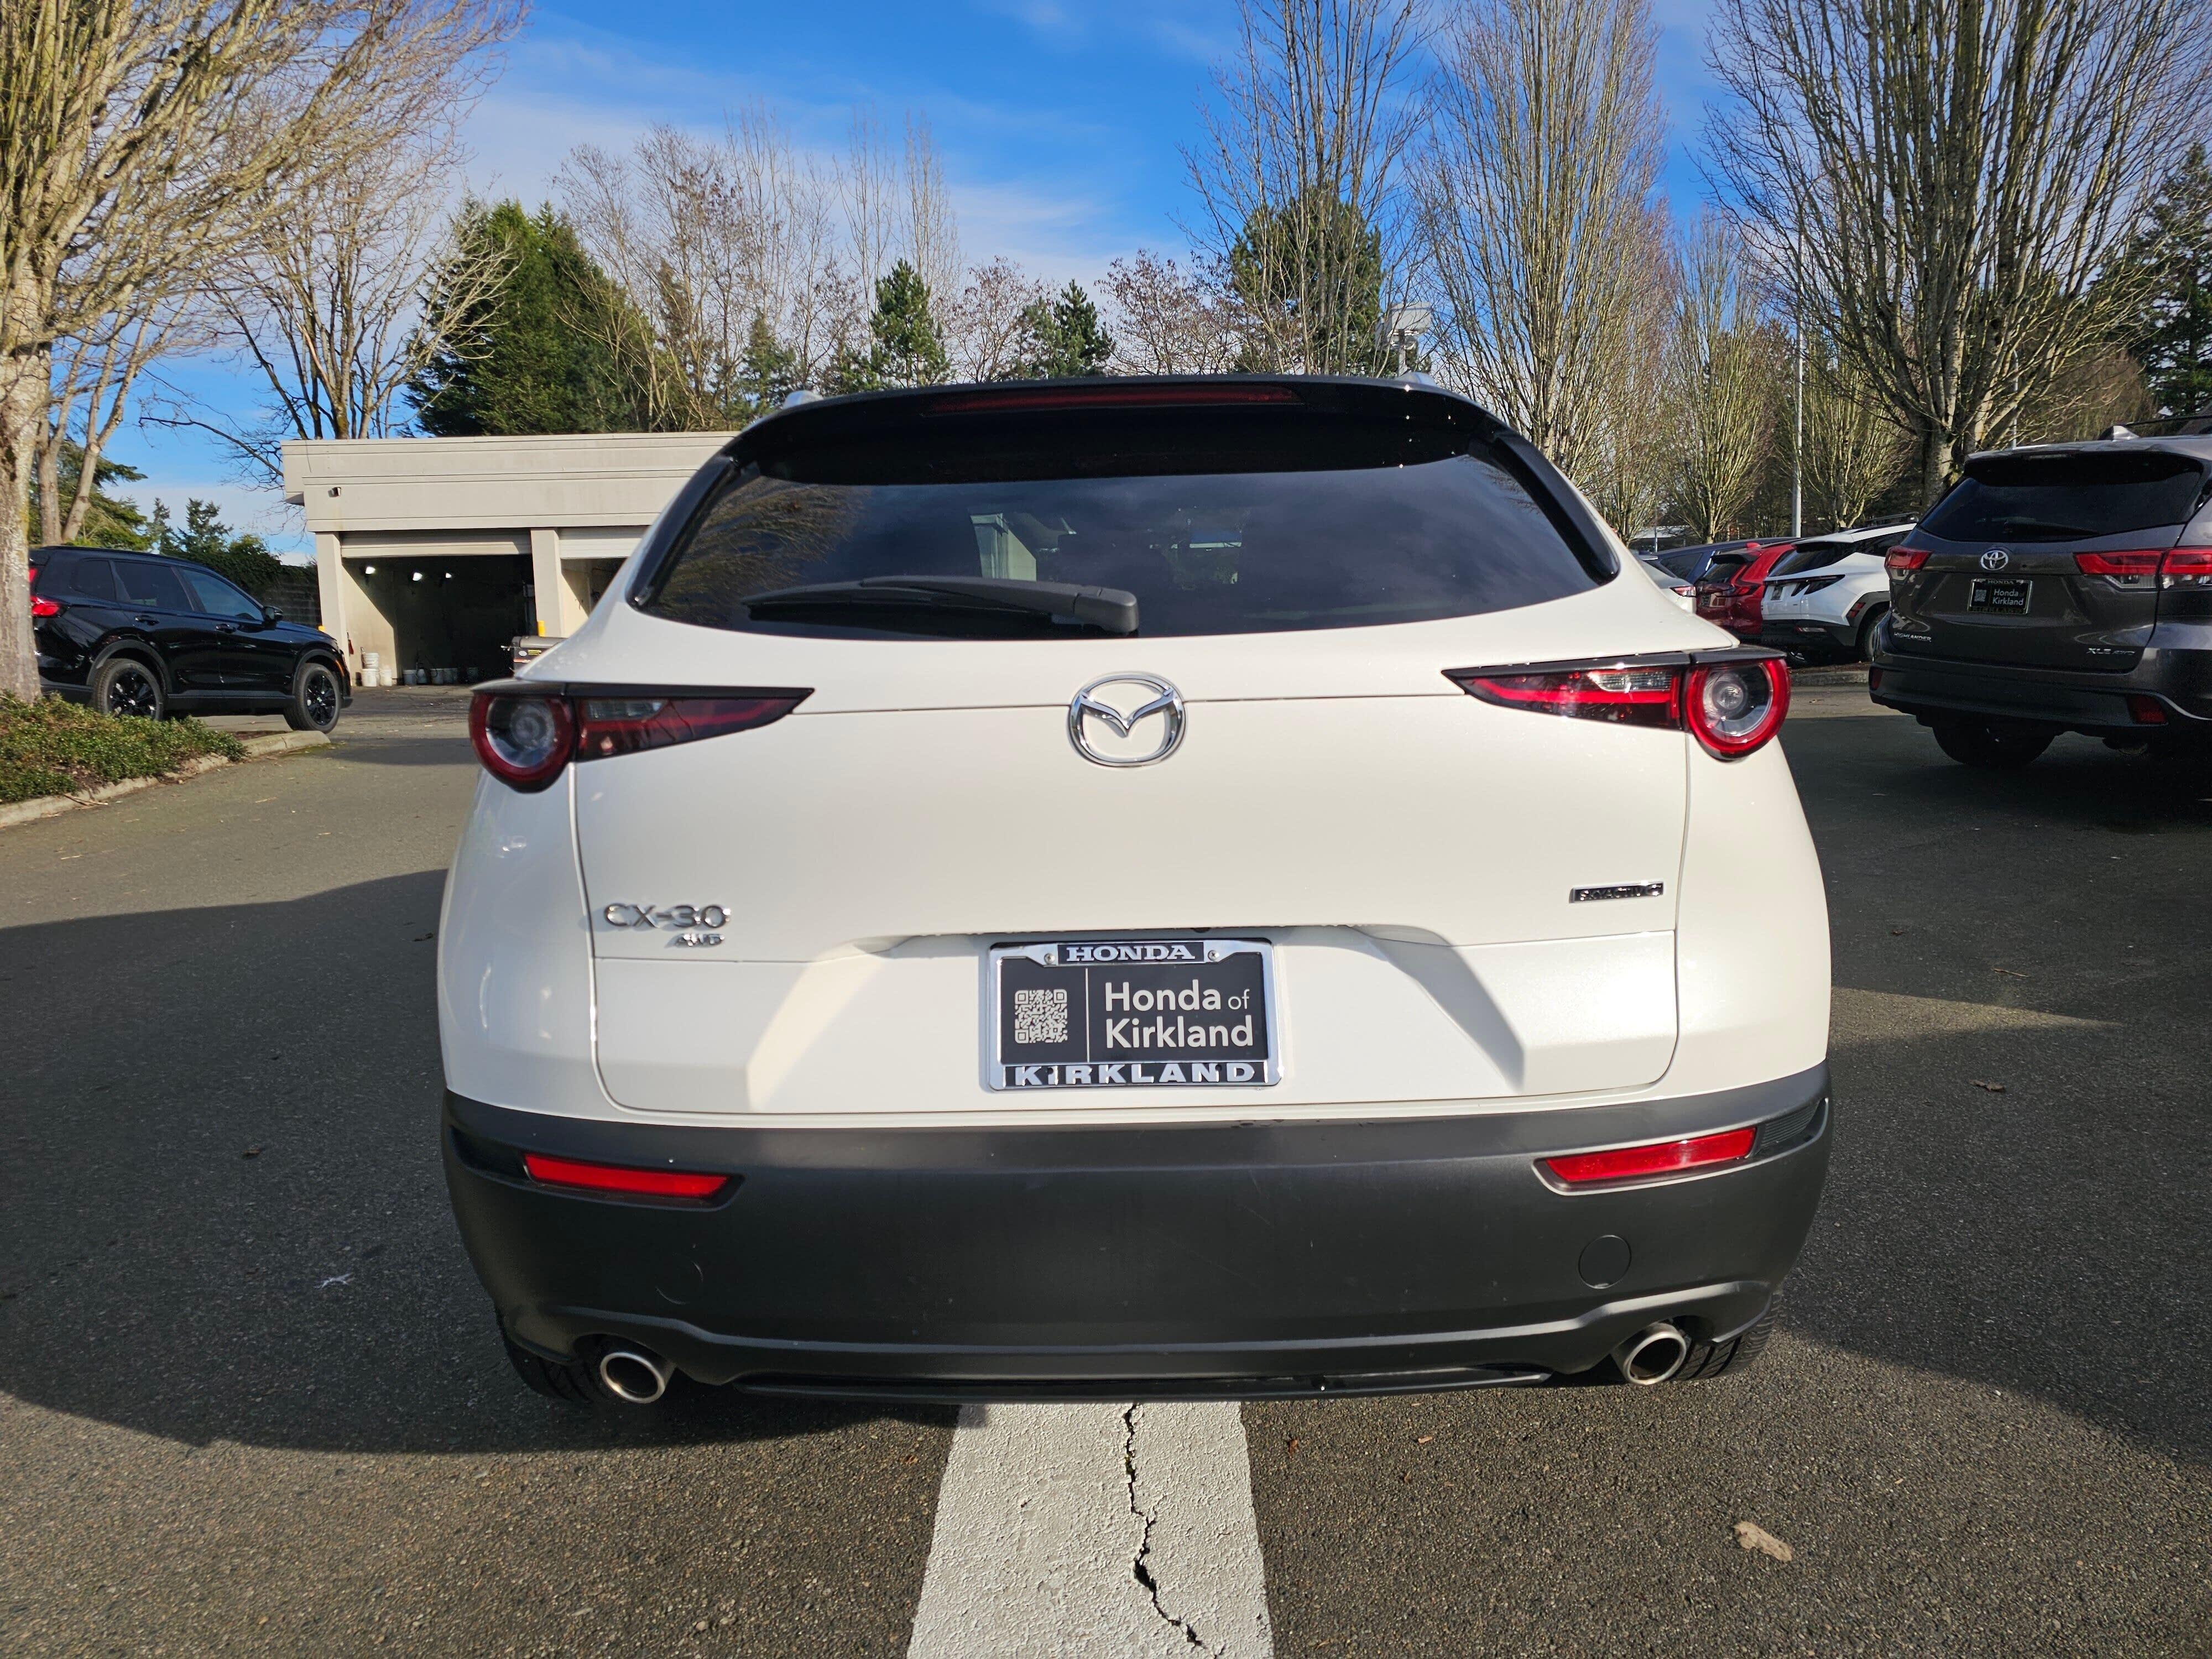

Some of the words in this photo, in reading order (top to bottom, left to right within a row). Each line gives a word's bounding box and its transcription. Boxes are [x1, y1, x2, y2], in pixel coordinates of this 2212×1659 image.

[1992, 597, 2024, 606] Kirkland
[1994, 588, 2019, 597] Honda
[1893, 632, 1932, 642] HIGHLANDER
[603, 903, 731, 928] CX-30
[1066, 945, 1196, 962] HONDA
[1105, 979, 1221, 1011] Honda
[1227, 989, 1250, 1010] of
[1105, 1015, 1254, 1048] Kirkland
[1015, 1063, 1255, 1086] KIRKLAND
